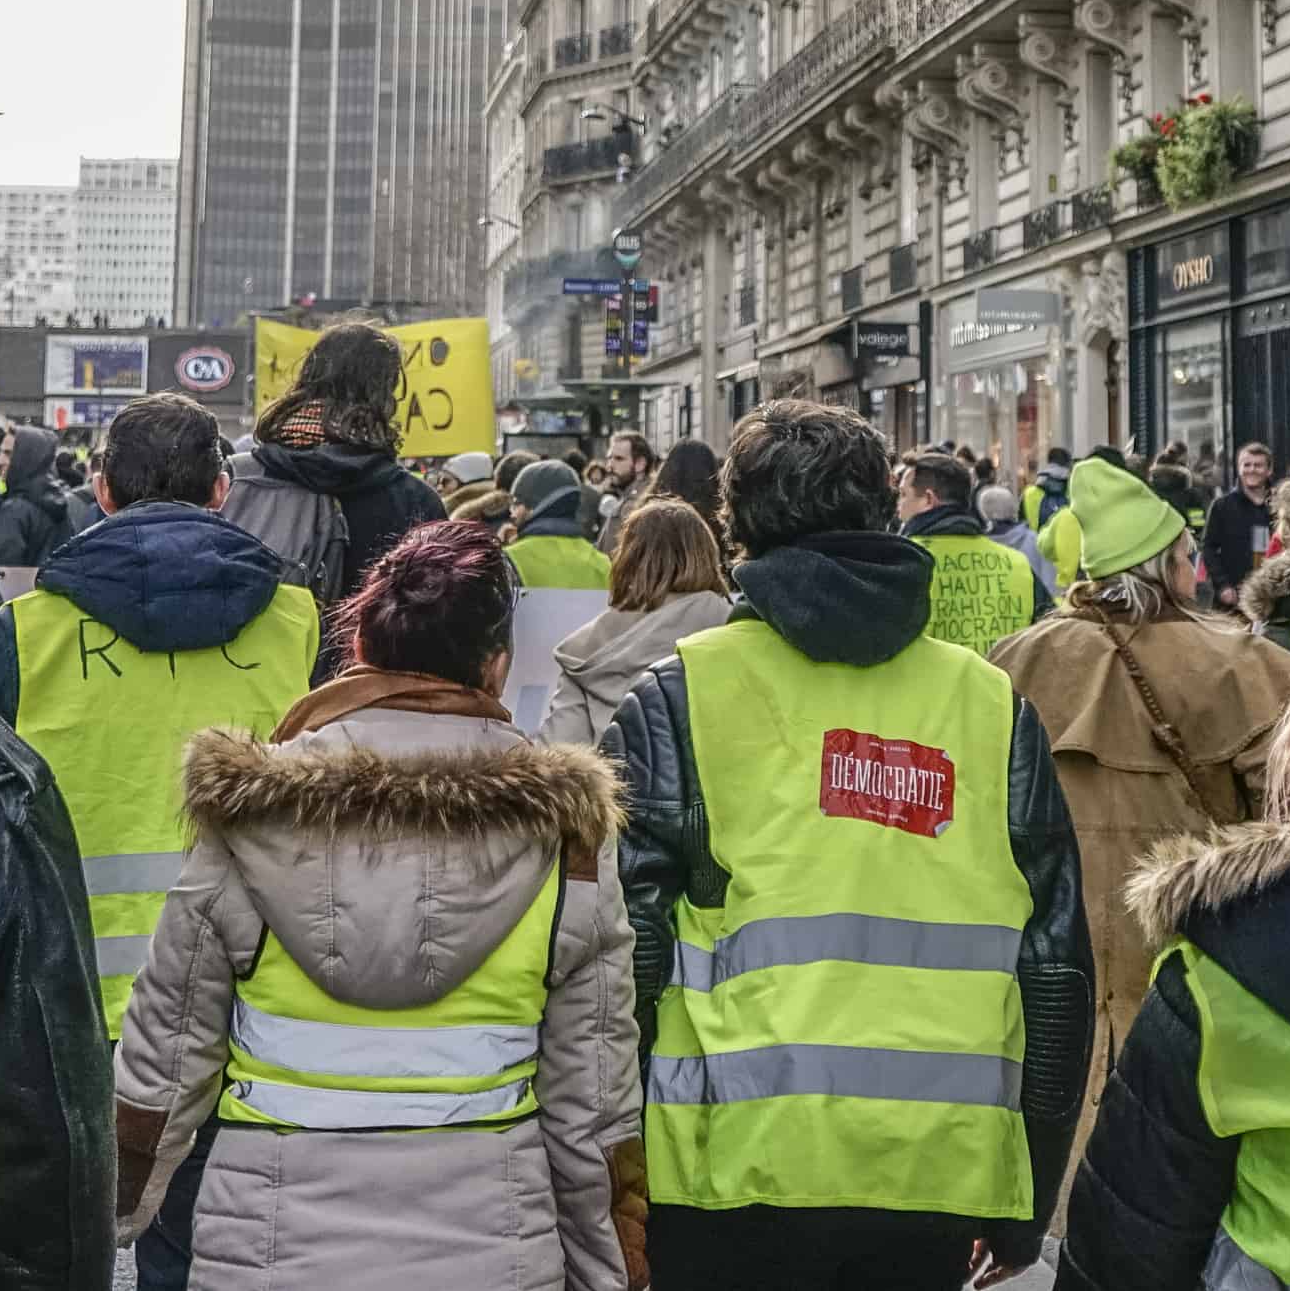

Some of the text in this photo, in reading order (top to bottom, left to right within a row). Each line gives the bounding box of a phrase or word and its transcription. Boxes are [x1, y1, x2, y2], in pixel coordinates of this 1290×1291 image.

[1173, 255, 1213, 291] OYSHO
[938, 573, 1010, 597] HAUTE
[931, 595, 1023, 619] RAHISON
[831, 752, 945, 811] DÉMOCRATIE
